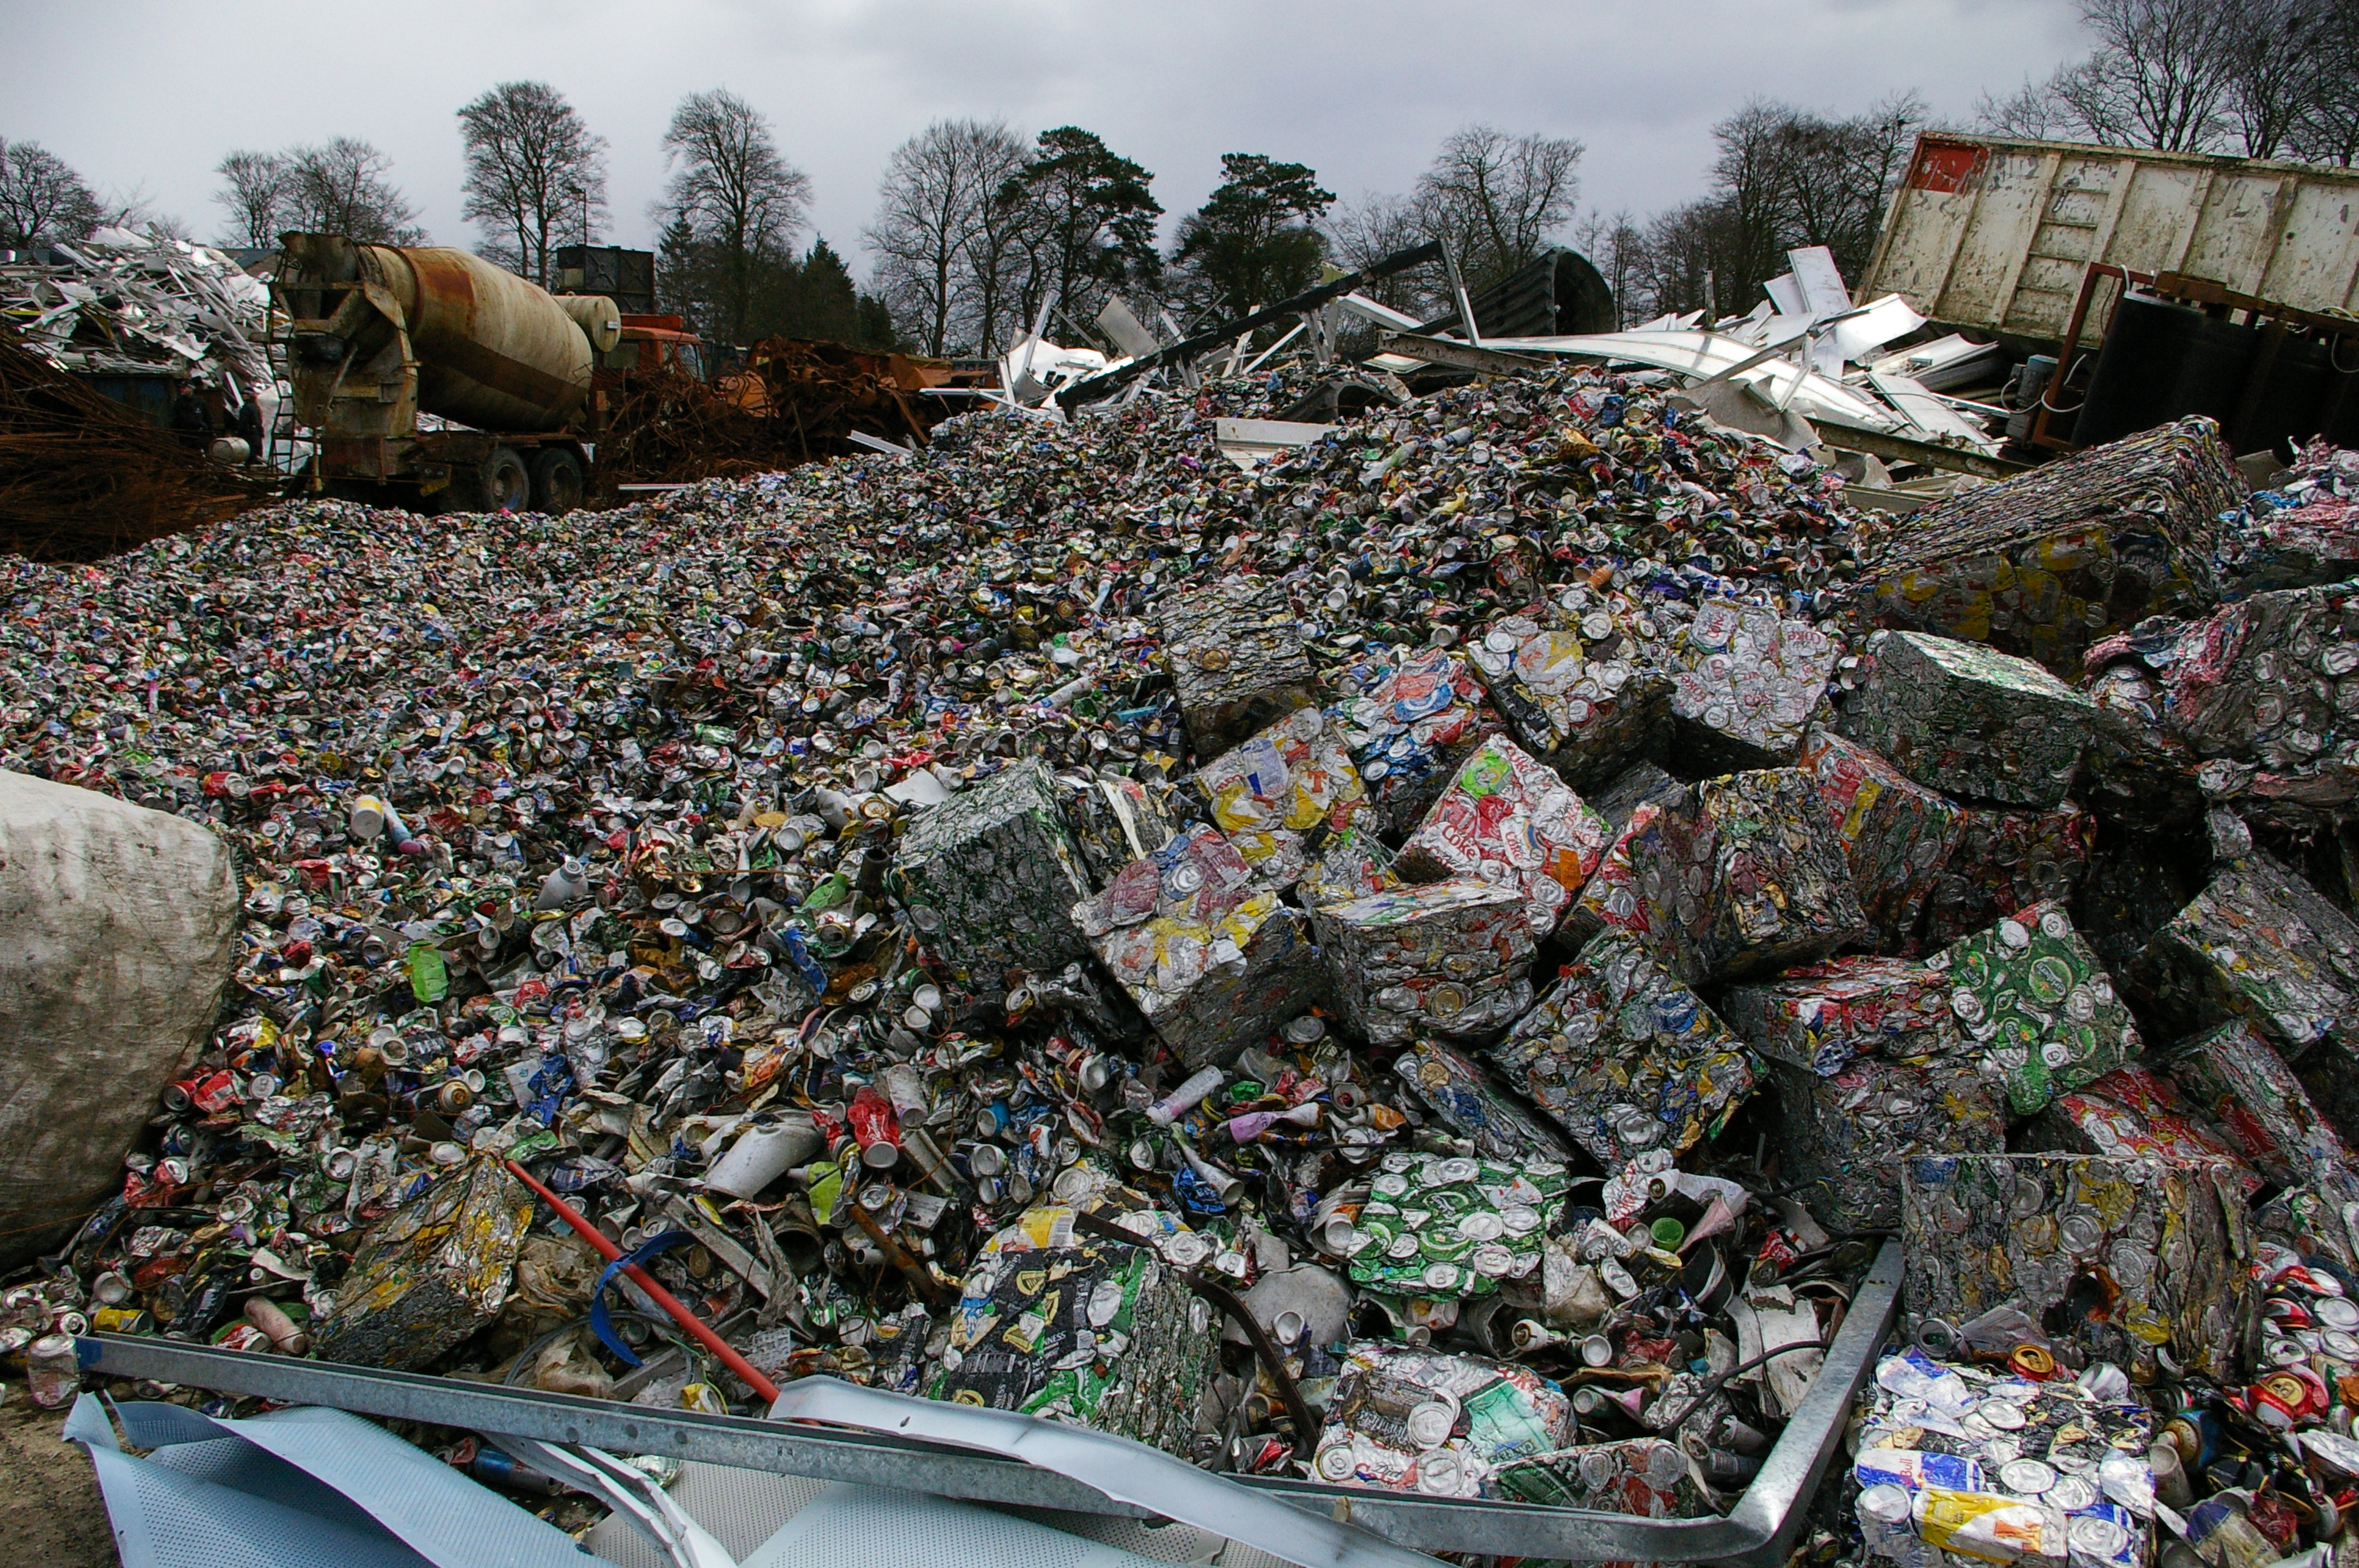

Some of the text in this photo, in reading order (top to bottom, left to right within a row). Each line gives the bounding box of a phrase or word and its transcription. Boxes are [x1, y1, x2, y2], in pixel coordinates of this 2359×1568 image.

[1787, 630, 1822, 645] Coke
[1441, 825, 1477, 862] Coke
[1505, 831, 1524, 862] Coke
[2036, 962, 2066, 996] Carlsberg
[1609, 1234, 1630, 1255] LYNX
[1899, 1457, 1913, 1478] Bull
